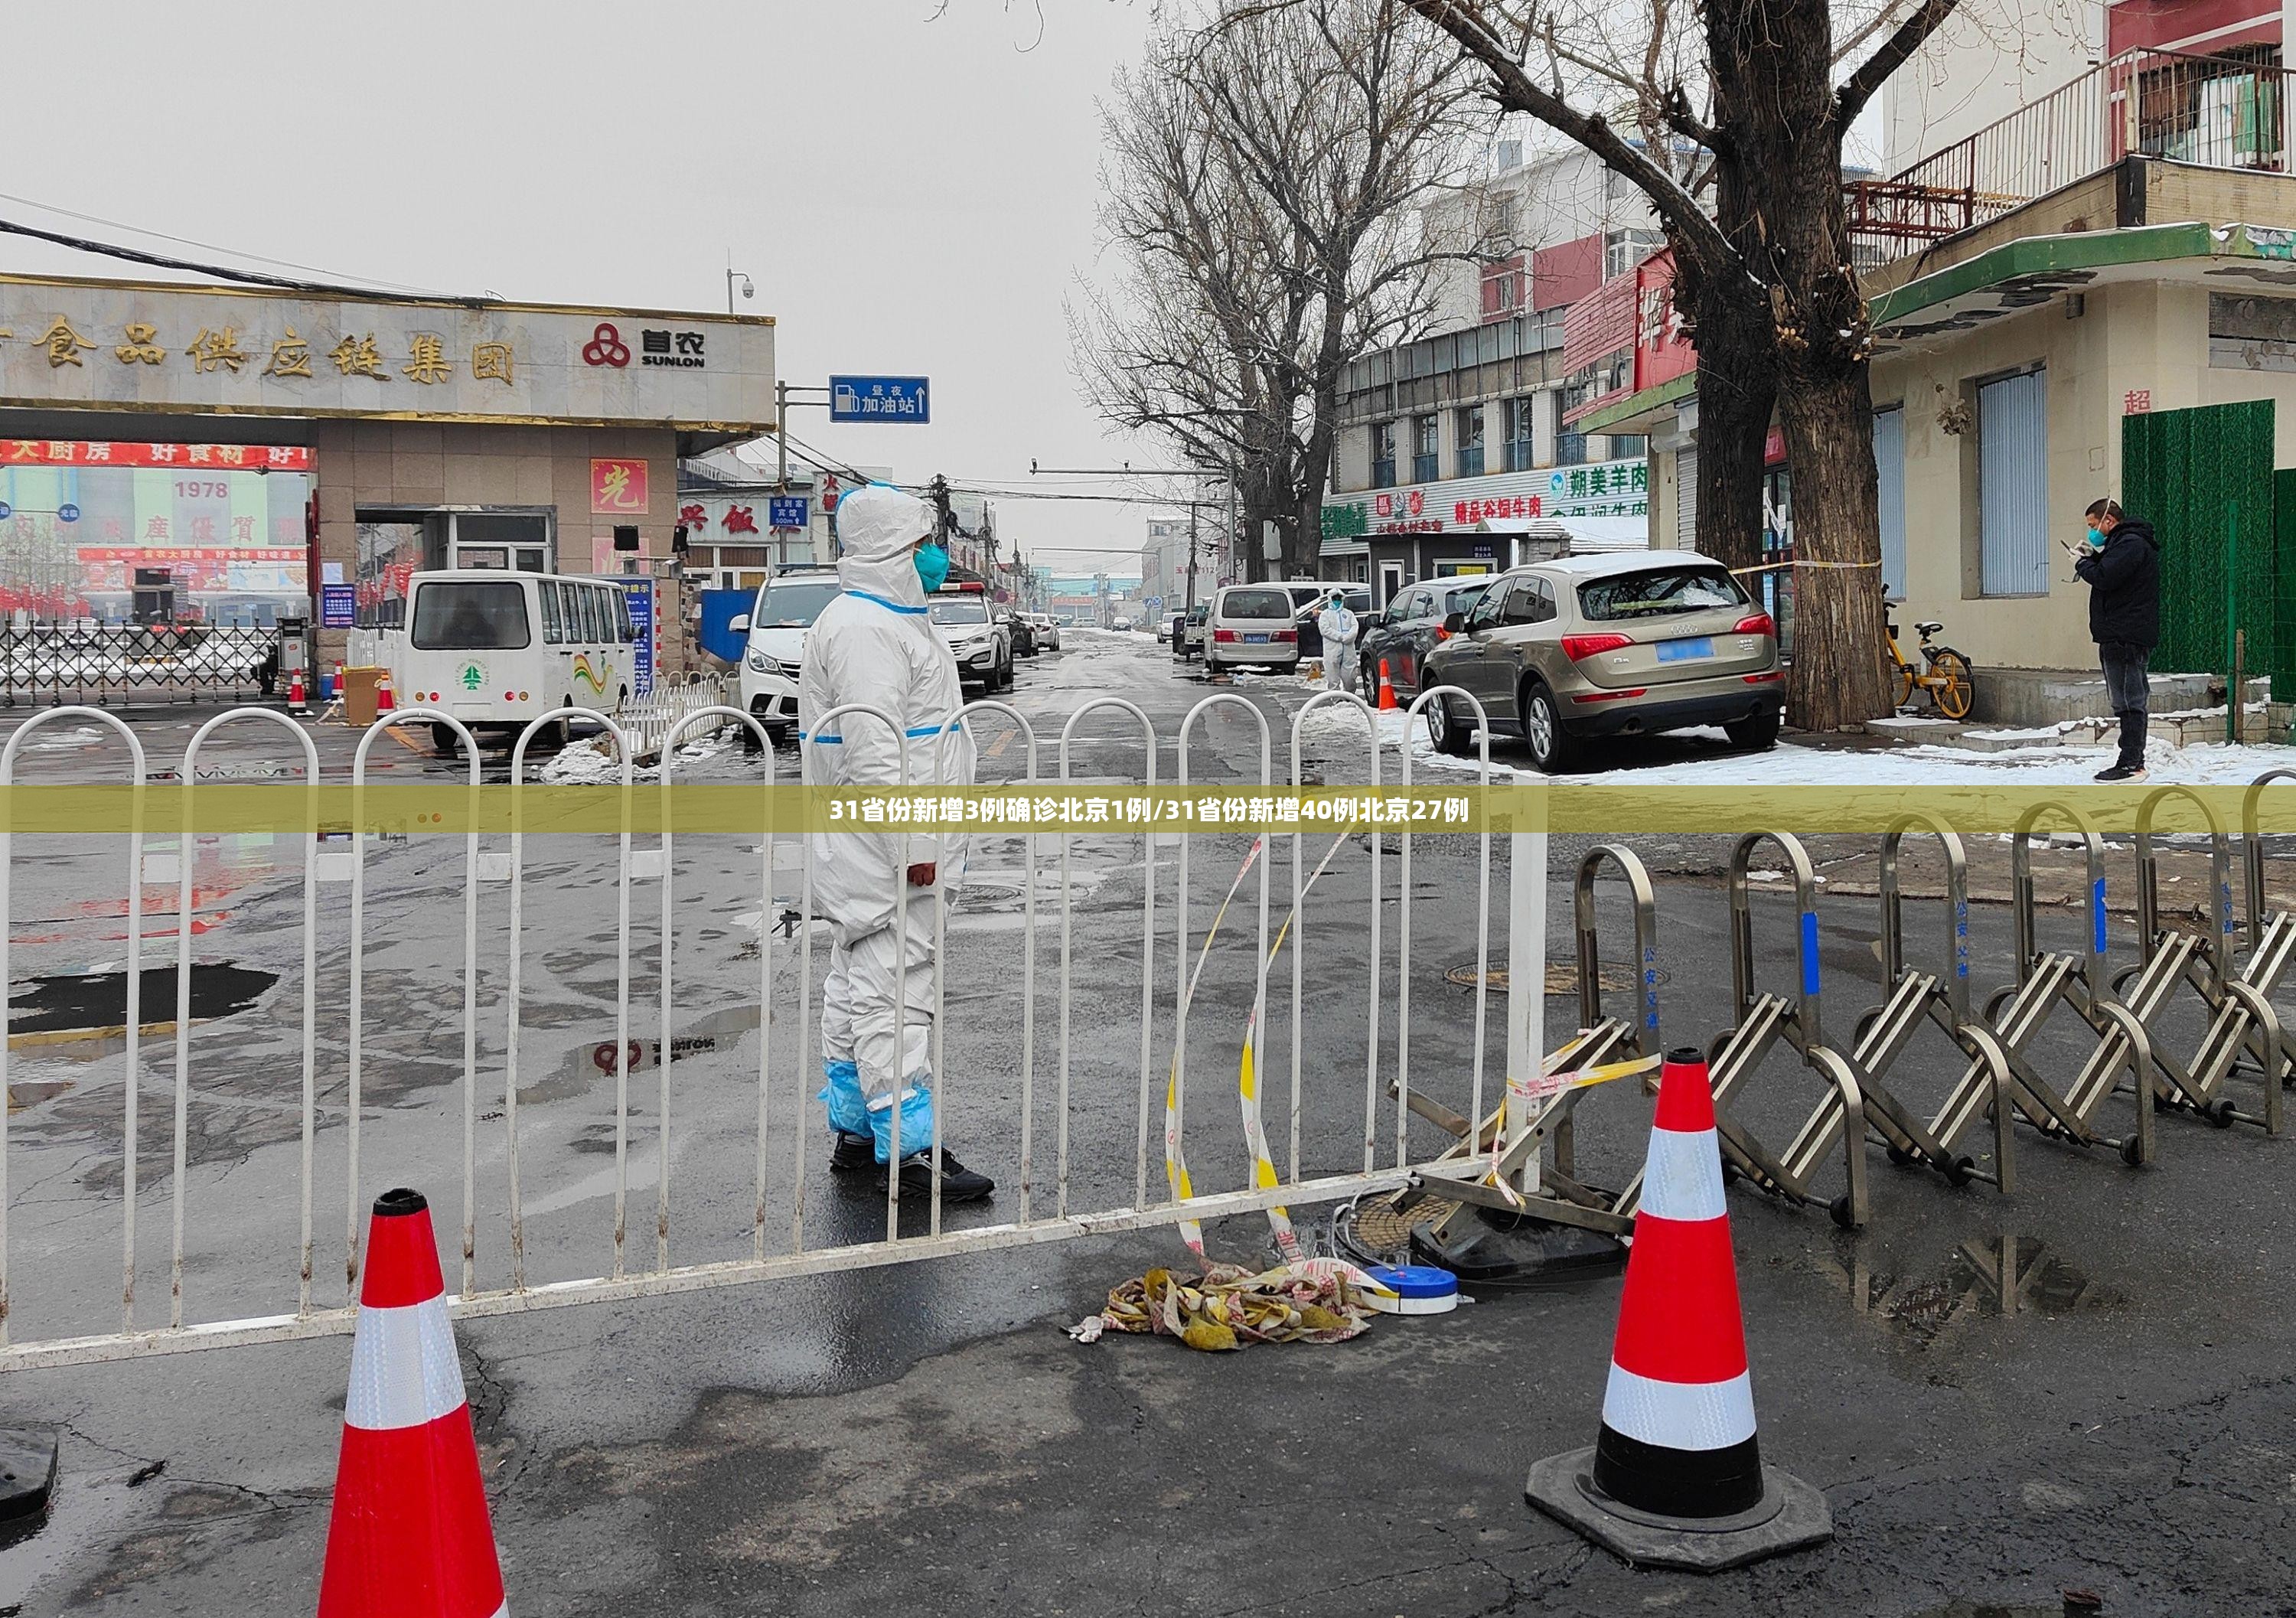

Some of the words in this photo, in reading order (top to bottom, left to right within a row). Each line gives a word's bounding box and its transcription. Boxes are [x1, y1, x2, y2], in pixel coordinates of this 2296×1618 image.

[0, 315, 514, 386] 食品供应链集团
[641, 329, 704, 354] 首农
[641, 355, 705, 367] SUNLON
[872, 385, 902, 396] 昼夜
[862, 396, 915, 414] 加油站
[2124, 390, 2151, 414] 超
[174, 481, 228, 497] 1978
[598, 465, 641, 508] 光
